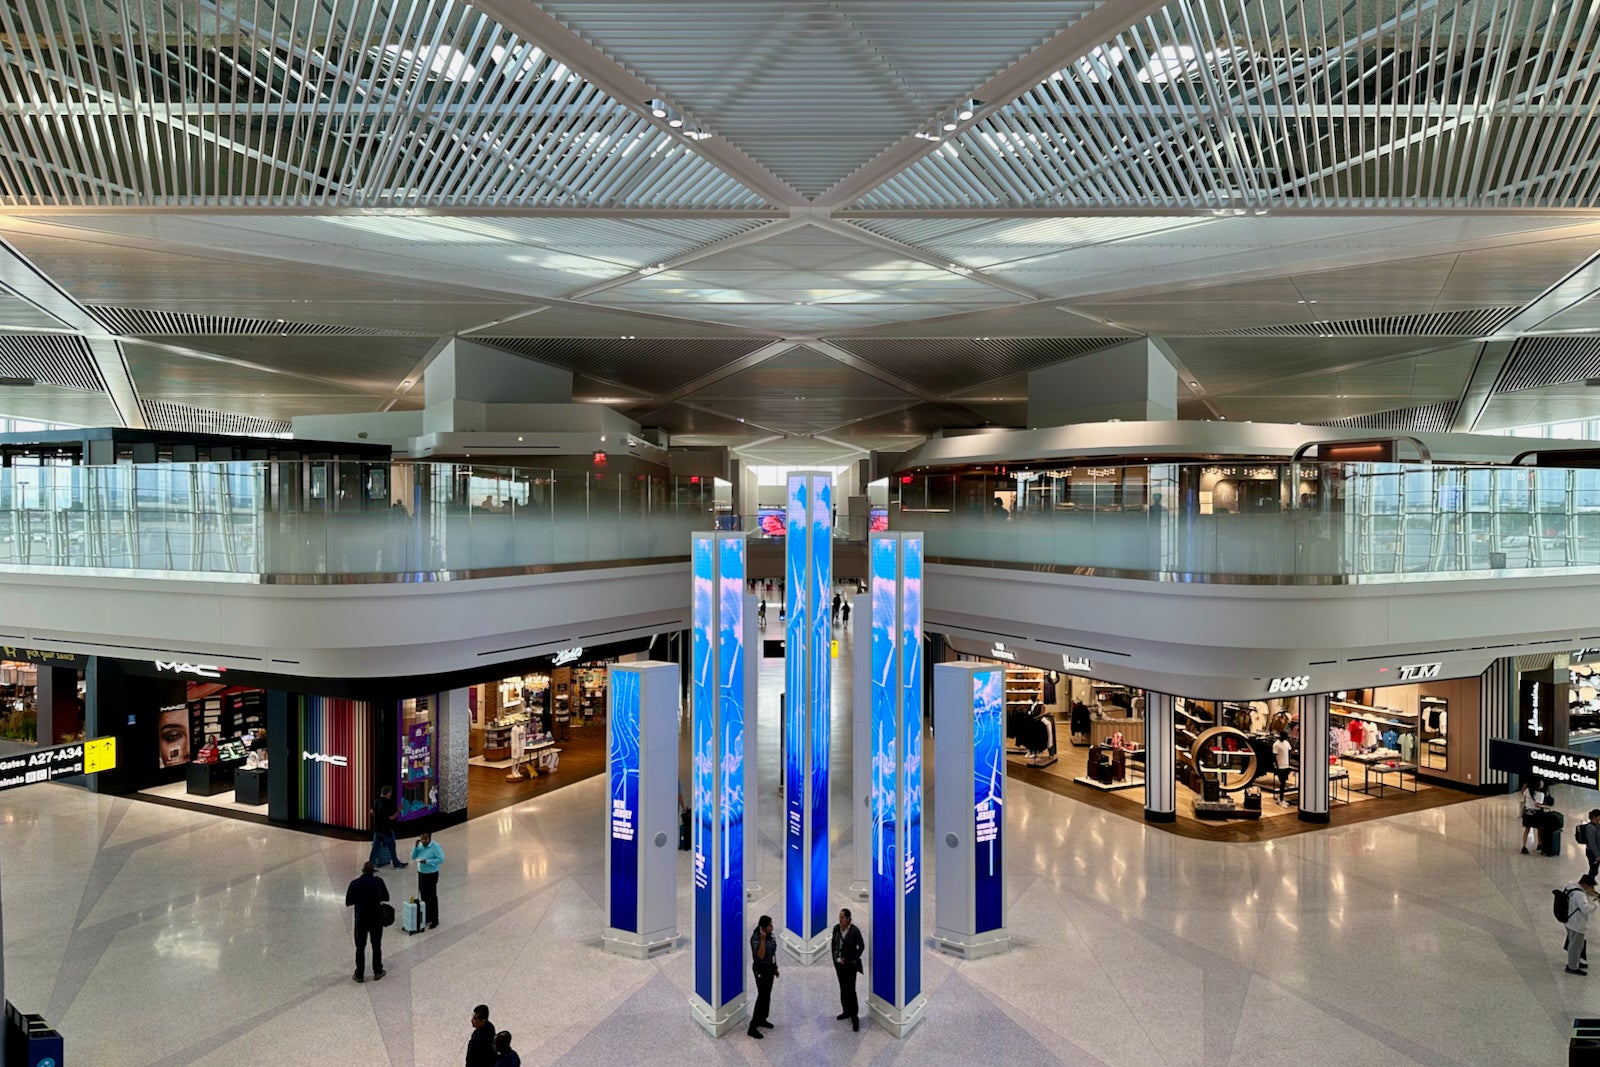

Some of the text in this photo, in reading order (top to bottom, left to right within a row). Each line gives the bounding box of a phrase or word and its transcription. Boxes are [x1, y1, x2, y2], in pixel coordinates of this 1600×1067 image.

[155, 660, 221, 678] MAC
[1268, 675, 1311, 693] BOSS
[0, 745, 83, 771] Gates A27-A34
[303, 751, 348, 767] MAC
[1530, 750, 1597, 772] Gates A1-A8
[1532, 765, 1597, 786] Baggage Claim
